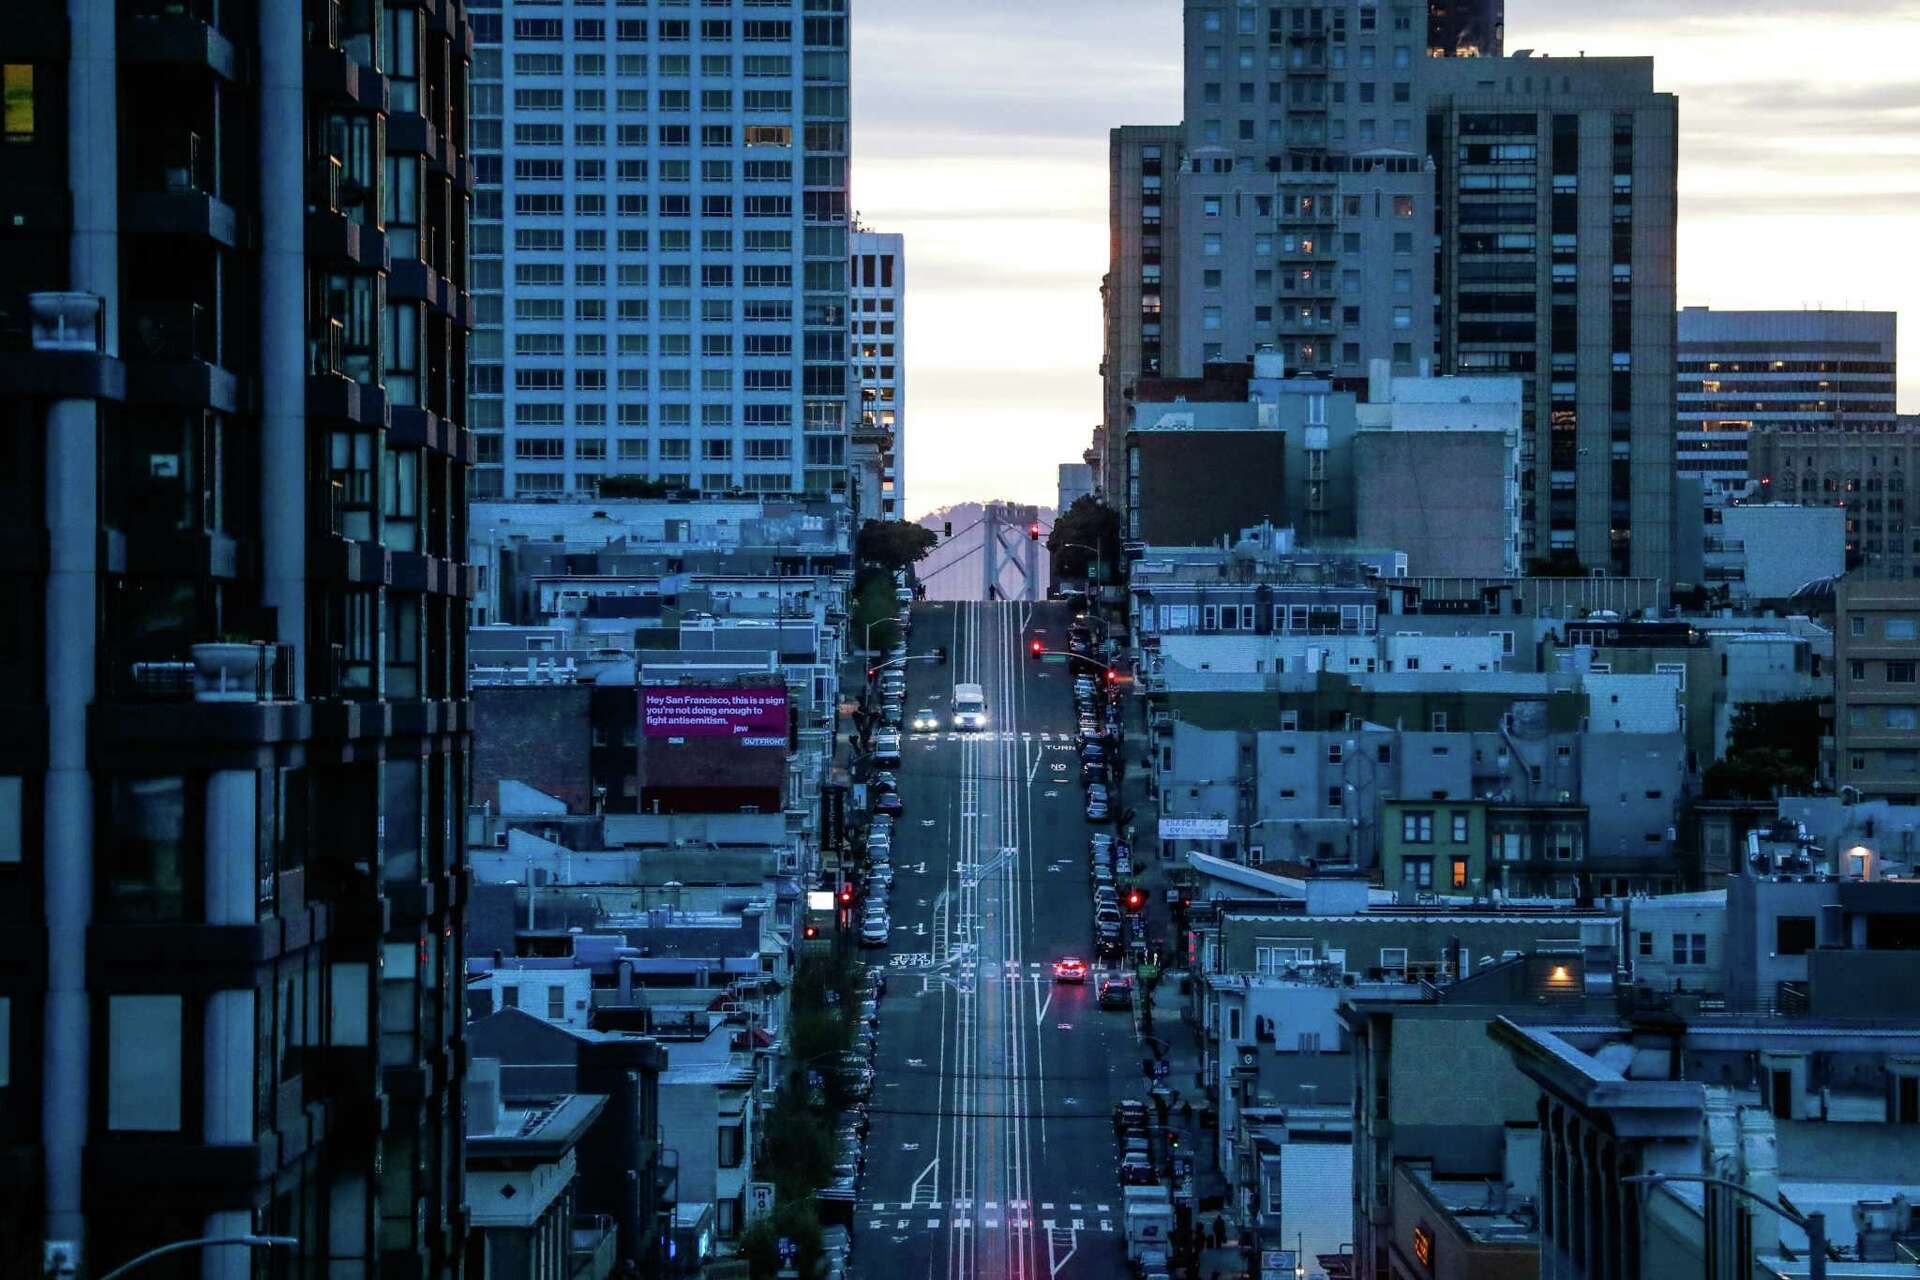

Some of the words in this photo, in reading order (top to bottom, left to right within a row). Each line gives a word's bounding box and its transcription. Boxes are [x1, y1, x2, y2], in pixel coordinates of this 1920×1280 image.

[646, 695, 664, 706] Hey
[665, 695, 684, 705] San
[684, 695, 731, 706] Francisco,
[732, 695, 749, 705] this
[750, 695, 758, 705] is
[765, 695, 785, 706] sign
[646, 705, 675, 716] you're
[675, 706, 691, 715] not
[691, 706, 718, 716] doing
[718, 706, 753, 716] enough
[753, 706, 763, 715] to
[646, 715, 667, 726] fight
[668, 715, 729, 725] antisemitism.
[1050, 763, 1067, 771] NO
